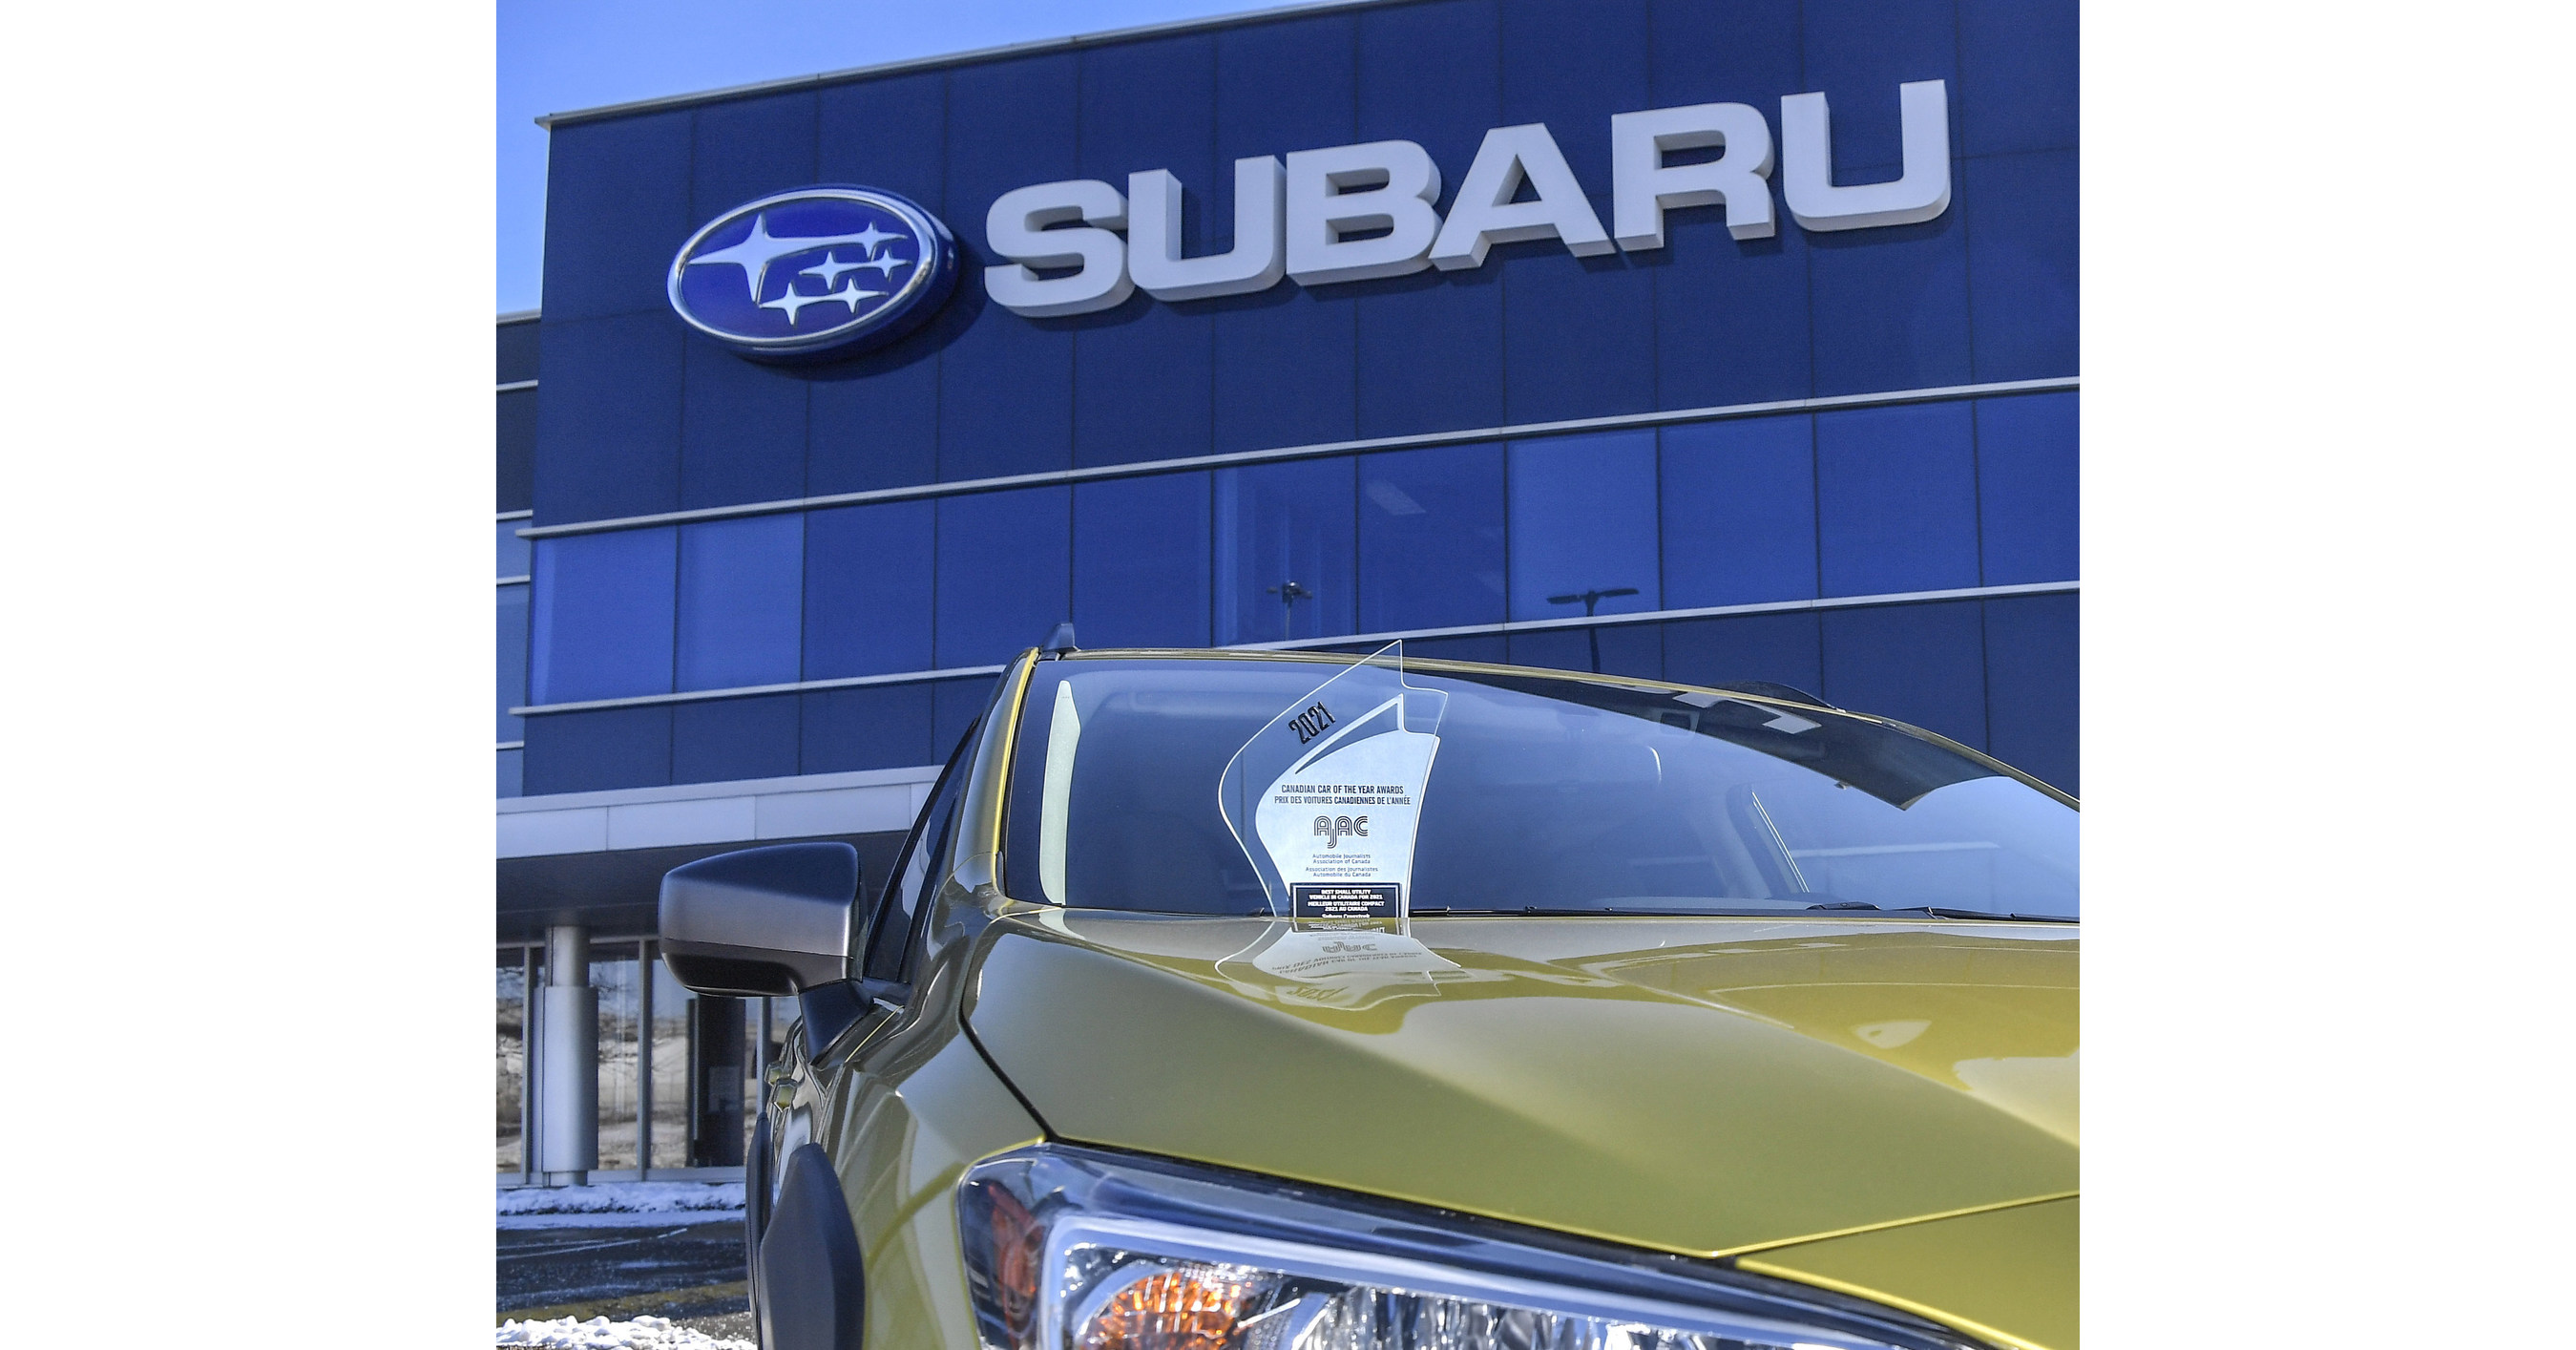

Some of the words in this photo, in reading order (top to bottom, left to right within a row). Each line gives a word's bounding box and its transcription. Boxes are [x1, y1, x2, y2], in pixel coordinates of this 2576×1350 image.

[985, 79, 1951, 317] SUBARU
[1288, 702, 1335, 744] 2021
[1282, 785, 1315, 793] CANADIAN
[1318, 785, 1331, 793] CAR
[1333, 785, 1342, 793] OF
[1344, 785, 1356, 793] THE
[1358, 786, 1374, 794] YEAR
[1377, 786, 1404, 794] AWARDS
[1334, 796, 1375, 805] CANADIENNES
[1387, 795, 1411, 805] L'ANNÉE
[1313, 815, 1368, 849] AJAC
